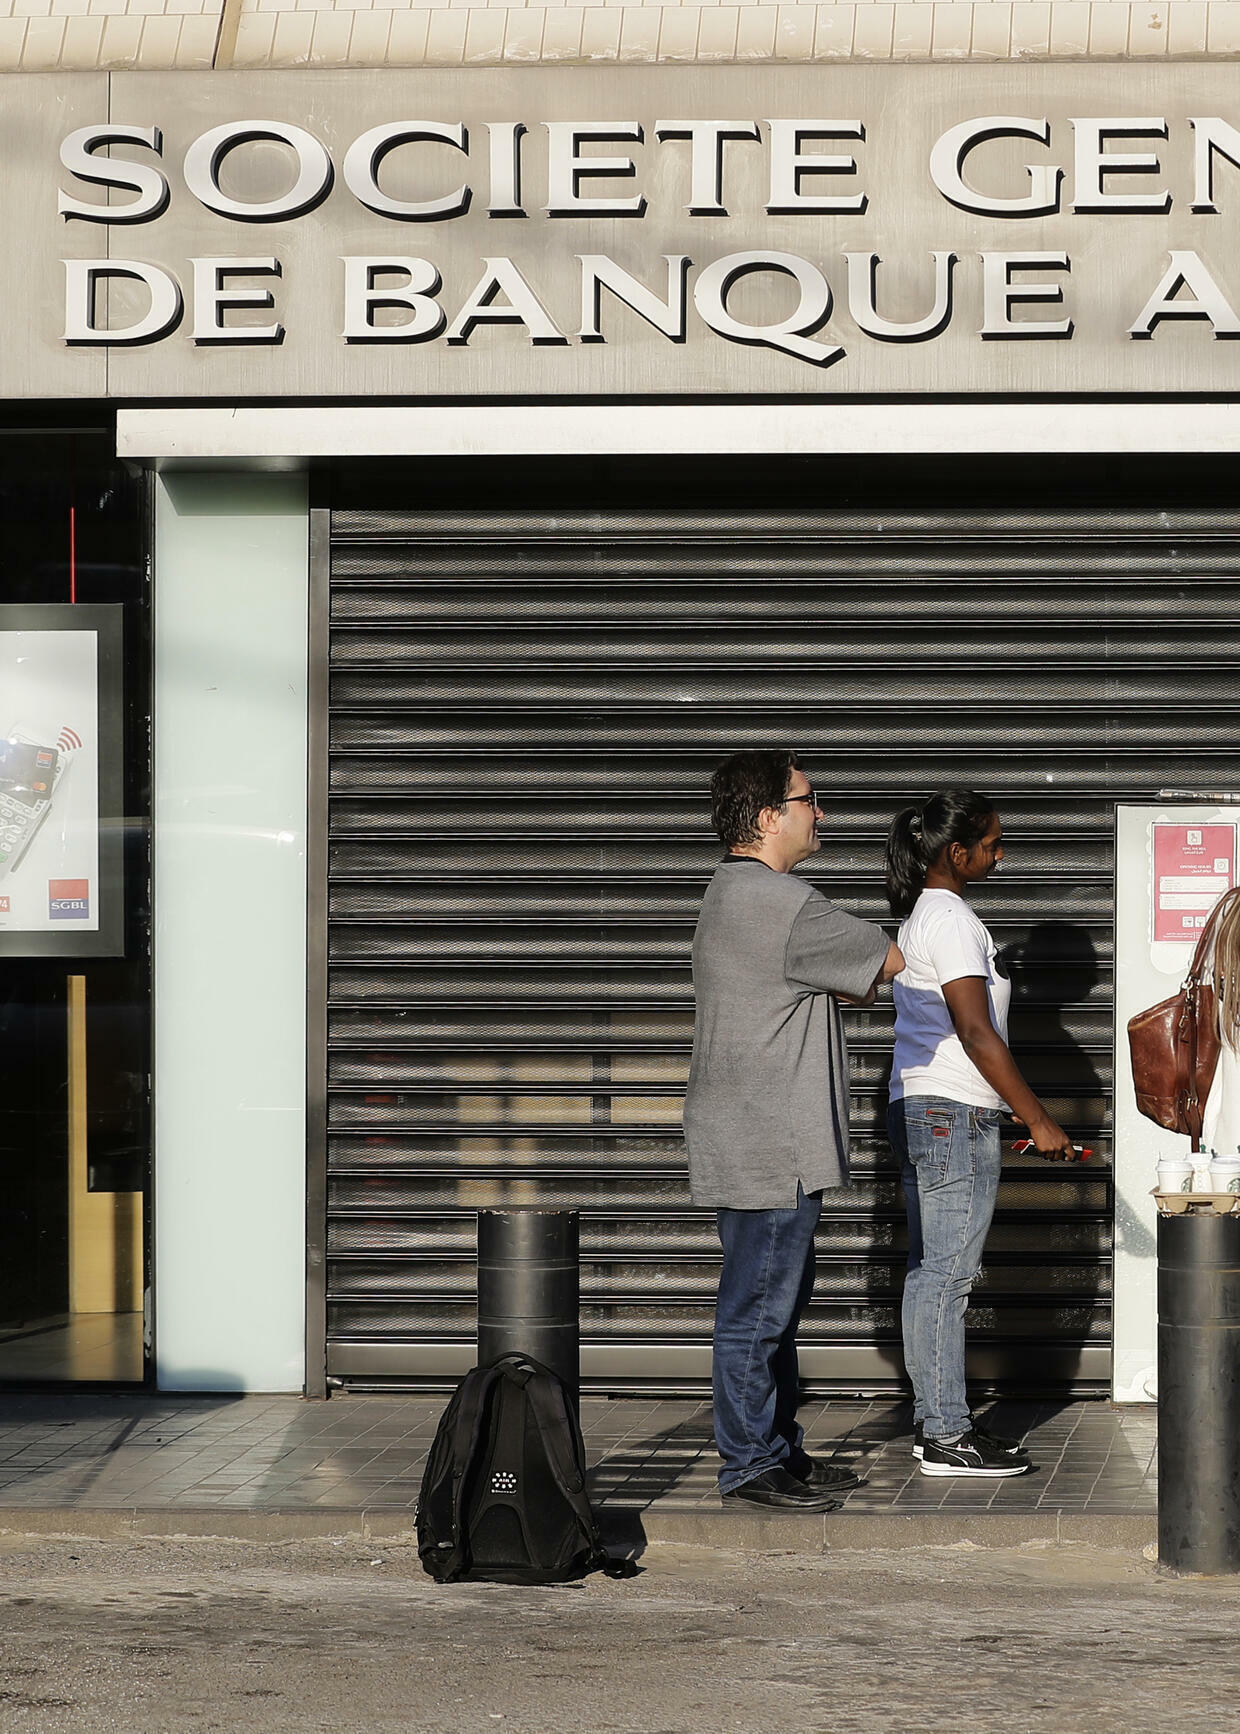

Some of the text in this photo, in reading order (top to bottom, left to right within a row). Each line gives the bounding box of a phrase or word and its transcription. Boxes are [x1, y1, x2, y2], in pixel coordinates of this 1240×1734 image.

[57, 118, 867, 221] SOCIETE
[60, 256, 286, 346] DE
[339, 248, 1074, 369] BANQUE
[0, 899, 9, 909] 4
[51, 901, 87, 910] SGBL
